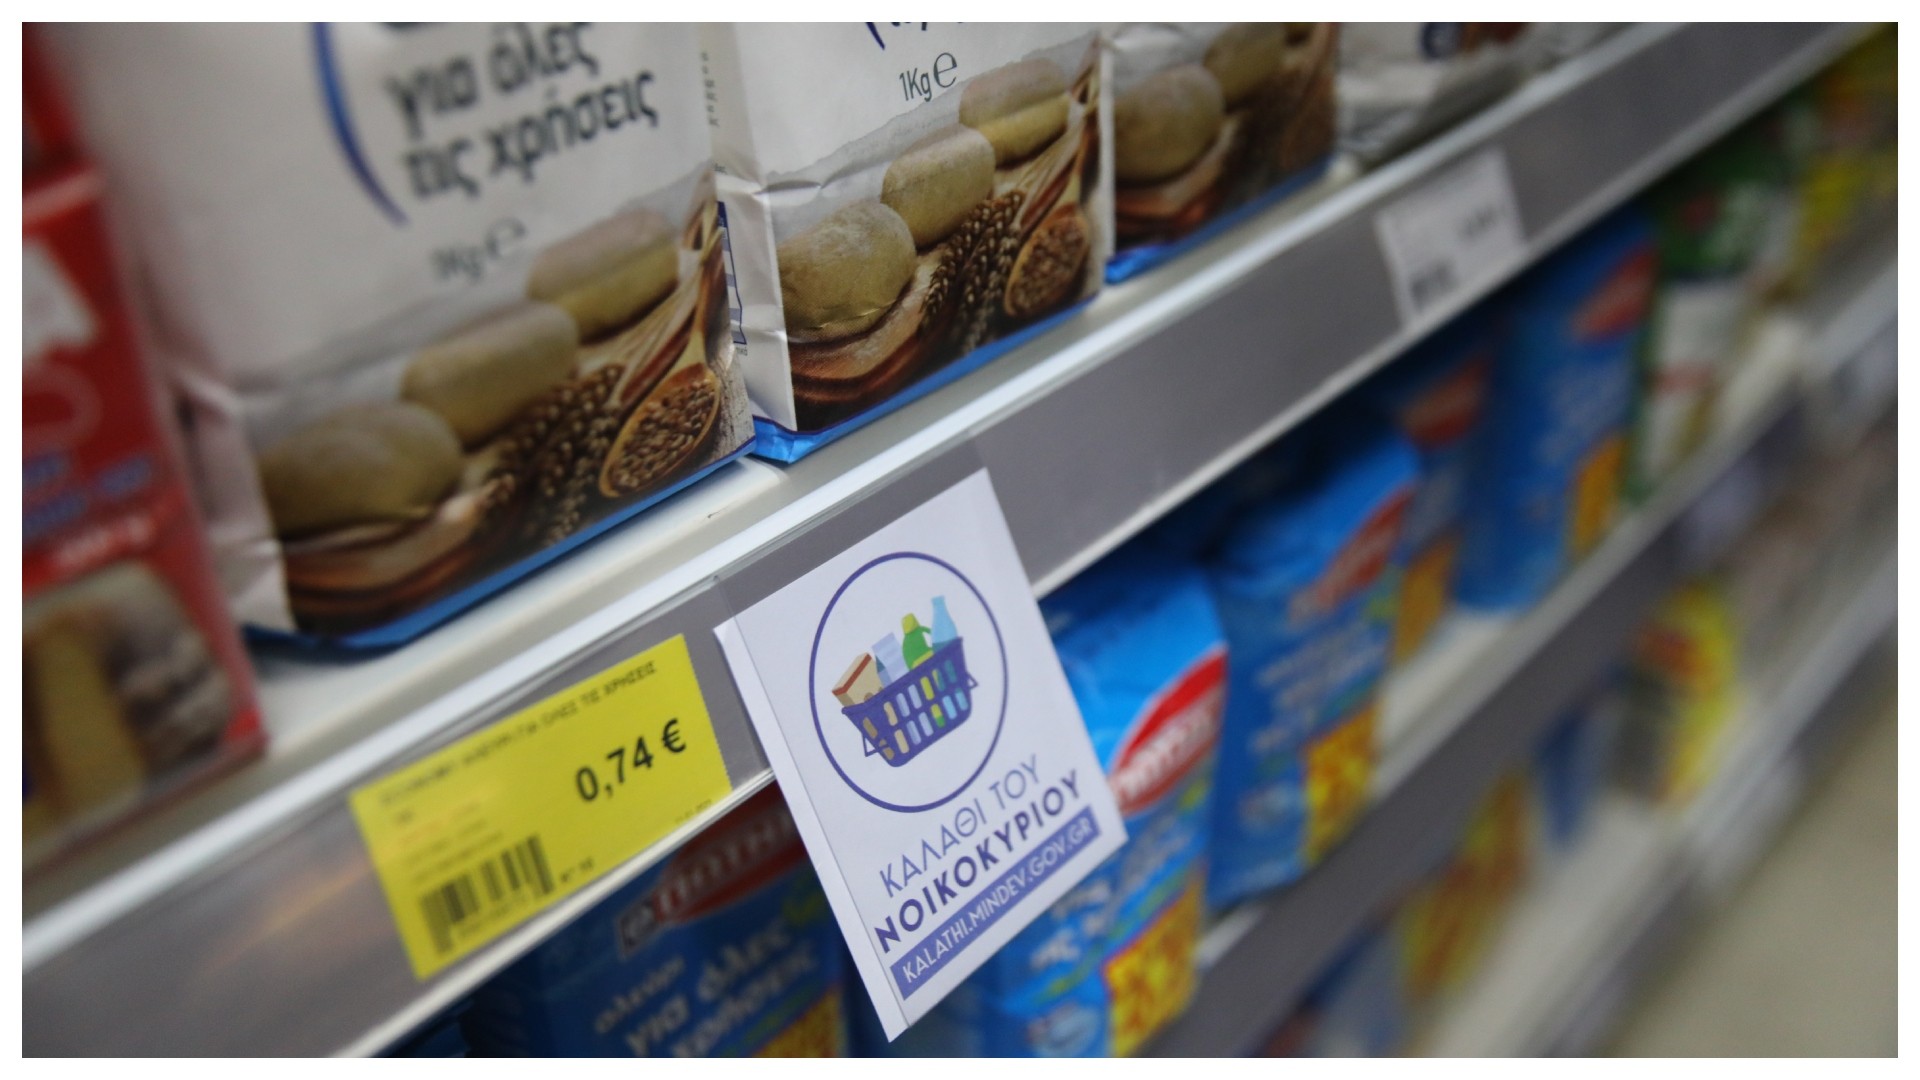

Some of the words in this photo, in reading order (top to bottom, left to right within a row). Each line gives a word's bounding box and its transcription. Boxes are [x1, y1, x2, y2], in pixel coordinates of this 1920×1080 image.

[483, 69, 659, 183] χρήσεις
[899, 67, 933, 102] 1Kg
[575, 736, 655, 803] 0,74
[660, 717, 688, 753] €
[873, 769, 1082, 954] ΝΟΙΚΟΚΥΡΙΟΥ
[879, 798, 988, 898] ΚΑΛΑΘΙ
[988, 754, 1043, 811] ΤΟΥ
[902, 817, 1096, 985] KALATHI.MINDEV.GOV.GR
